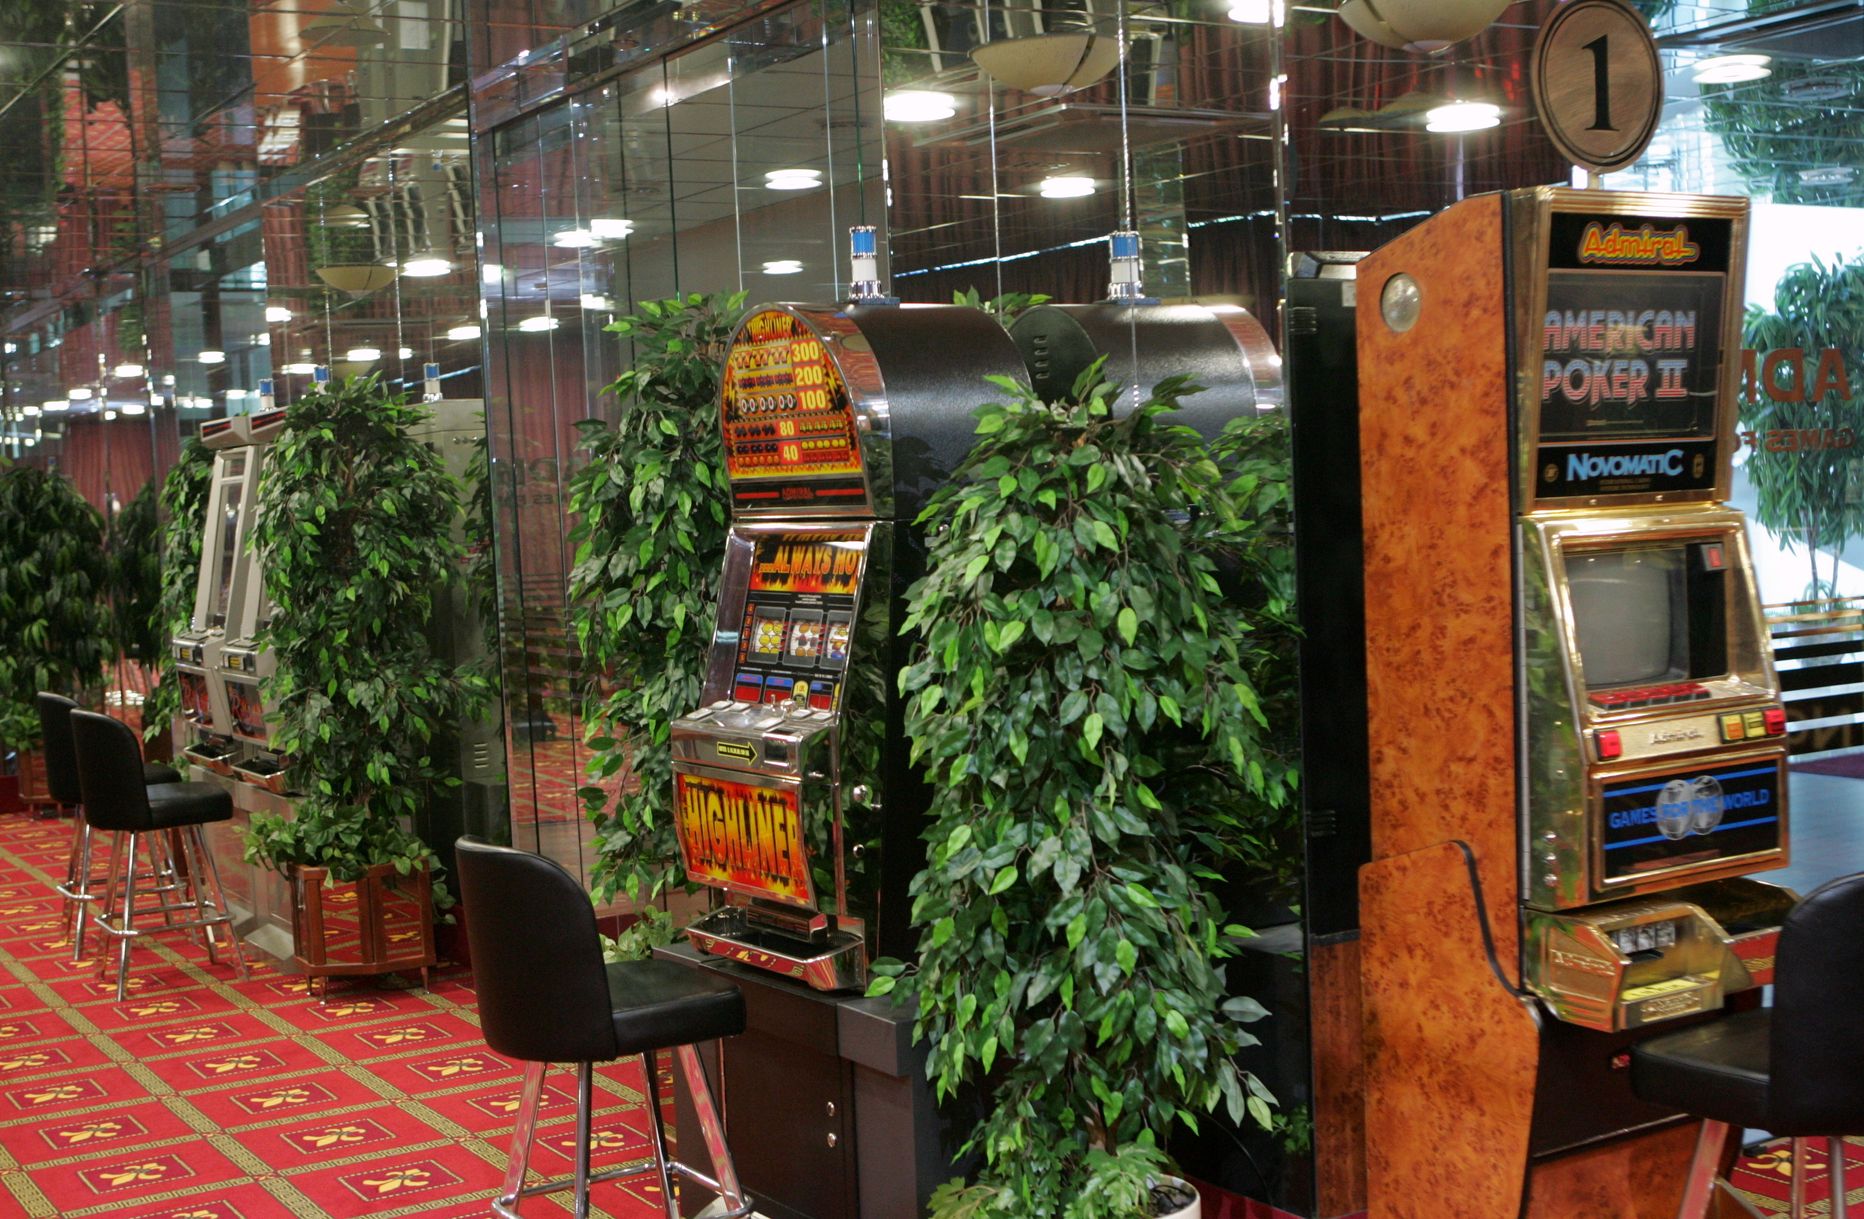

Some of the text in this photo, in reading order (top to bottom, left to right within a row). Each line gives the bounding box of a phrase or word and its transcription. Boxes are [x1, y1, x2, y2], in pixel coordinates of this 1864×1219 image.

[1582, 33, 1620, 132] 1
[1581, 224, 1698, 263] Admiral
[1543, 309, 1696, 353] AMERICAN
[792, 341, 820, 363] 300
[795, 365, 822, 386] 200
[1543, 358, 1688, 405] POKER II
[799, 390, 826, 412] 100
[779, 421, 795, 437] 80
[783, 445, 799, 462] 40
[1567, 449, 1684, 481] NOVOMATIC
[1608, 808, 1658, 829] GAMES
[1723, 789, 1770, 811] WORLD
